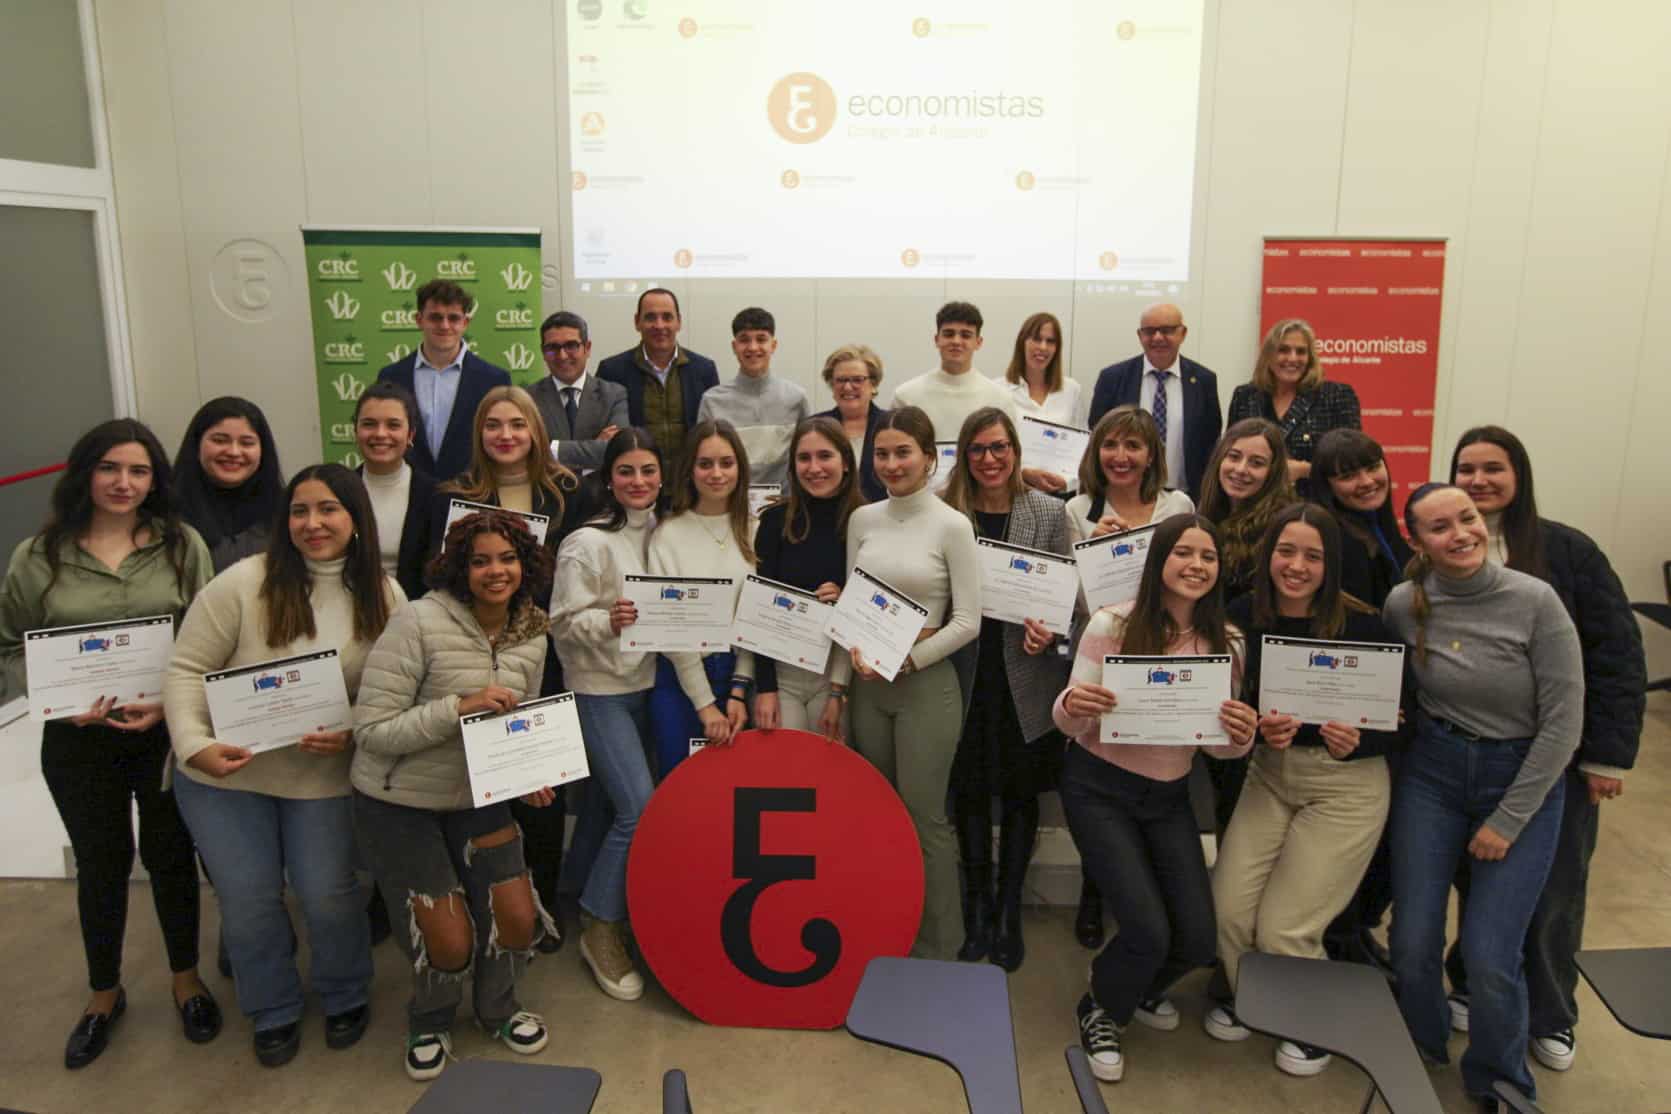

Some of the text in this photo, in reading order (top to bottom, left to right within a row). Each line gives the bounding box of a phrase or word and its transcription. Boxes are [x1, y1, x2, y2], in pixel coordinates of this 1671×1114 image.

[848, 89, 1045, 118] economistas
[318, 259, 360, 274] CRC
[436, 260, 477, 275] CRC
[495, 309, 533, 323] CRC
[325, 343, 365, 358] CRC
[1313, 336, 1428, 354] economistas
[331, 423, 357, 437] CR
